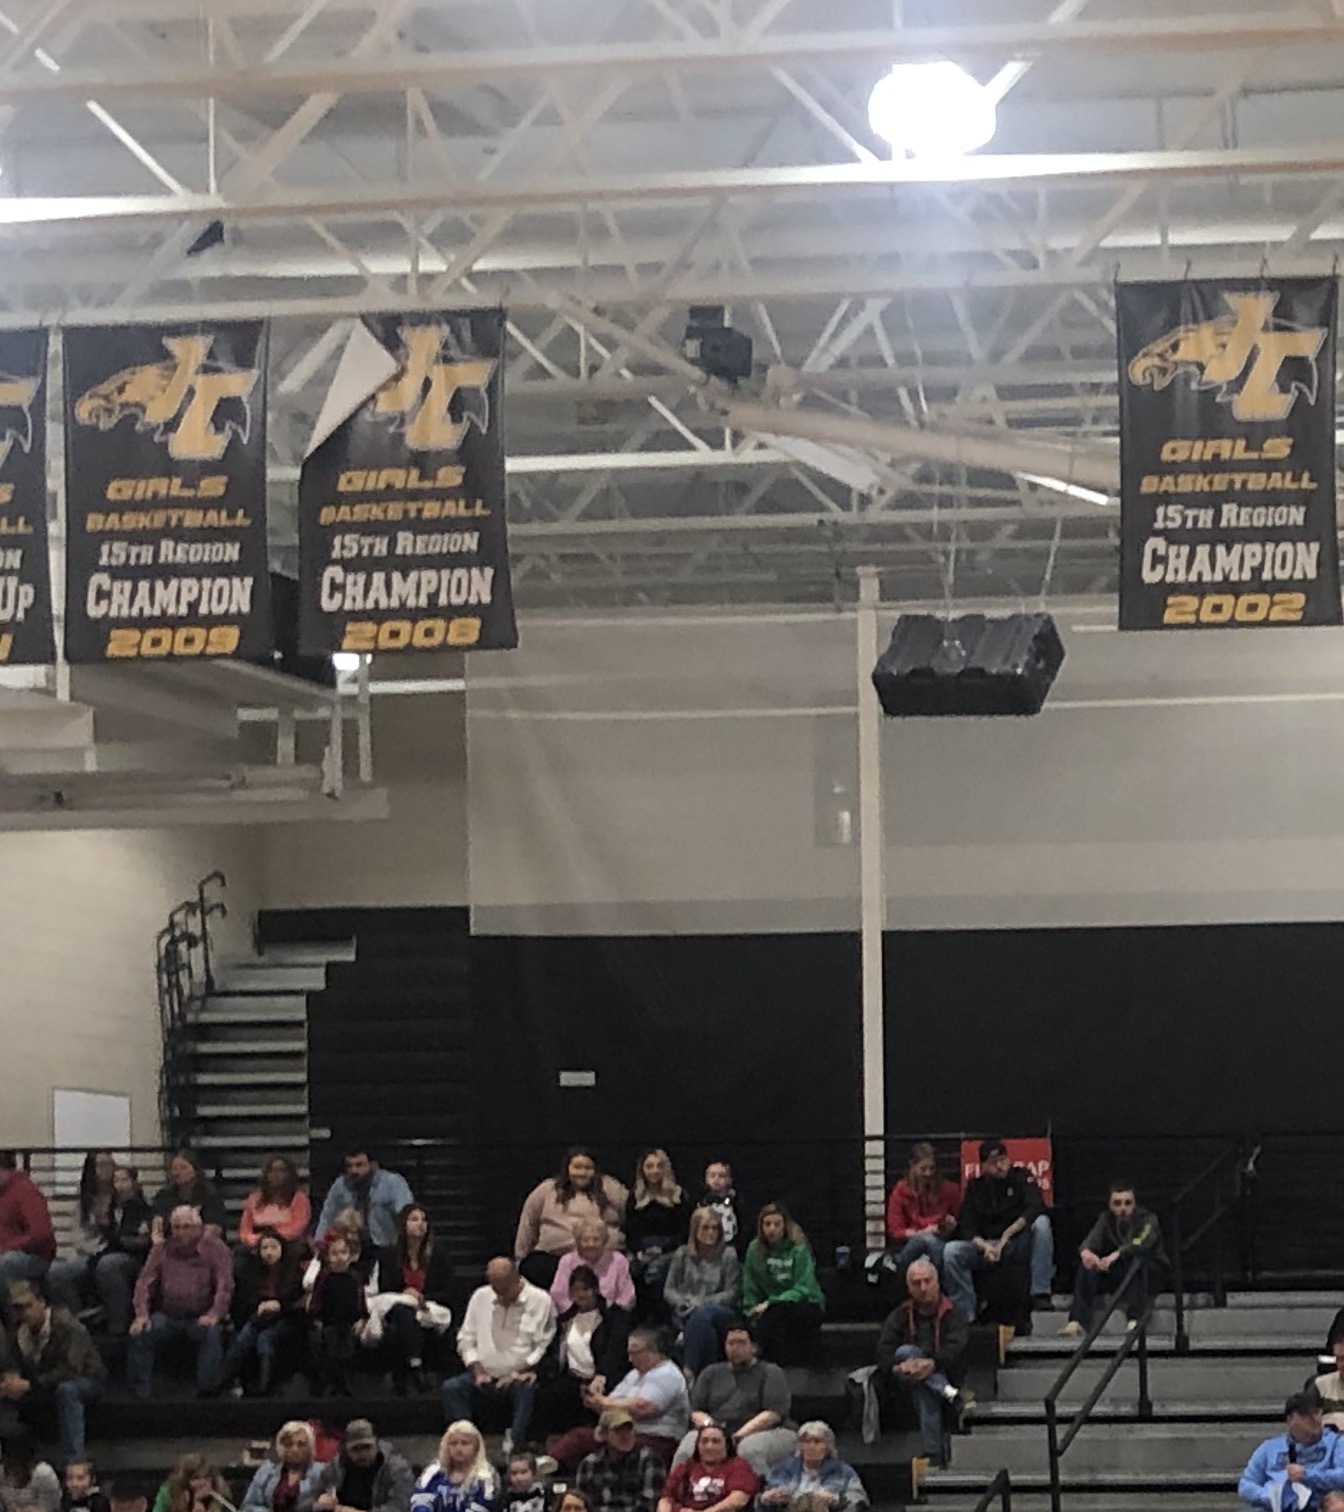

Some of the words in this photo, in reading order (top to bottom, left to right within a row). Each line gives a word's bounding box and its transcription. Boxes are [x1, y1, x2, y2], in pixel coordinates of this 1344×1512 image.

[1160, 437, 1293, 462] GIRLS
[106, 475, 229, 501] GIRLS
[337, 465, 466, 493] GIRLS
[1140, 470, 1318, 494] BASKETBALL
[86, 508, 252, 533] BASKETBALL
[319, 498, 491, 526] BASKETBALL
[1154, 503, 1214, 529] 15TH
[1219, 503, 1307, 528] REGION
[99, 541, 155, 567] 15TH
[331, 533, 389, 560] 15TH
[1141, 536, 1321, 584] CHAMPION
[86, 571, 254, 620] CHAMPION
[321, 565, 495, 613] CHAMPION
[1163, 593, 1306, 624] 2002
